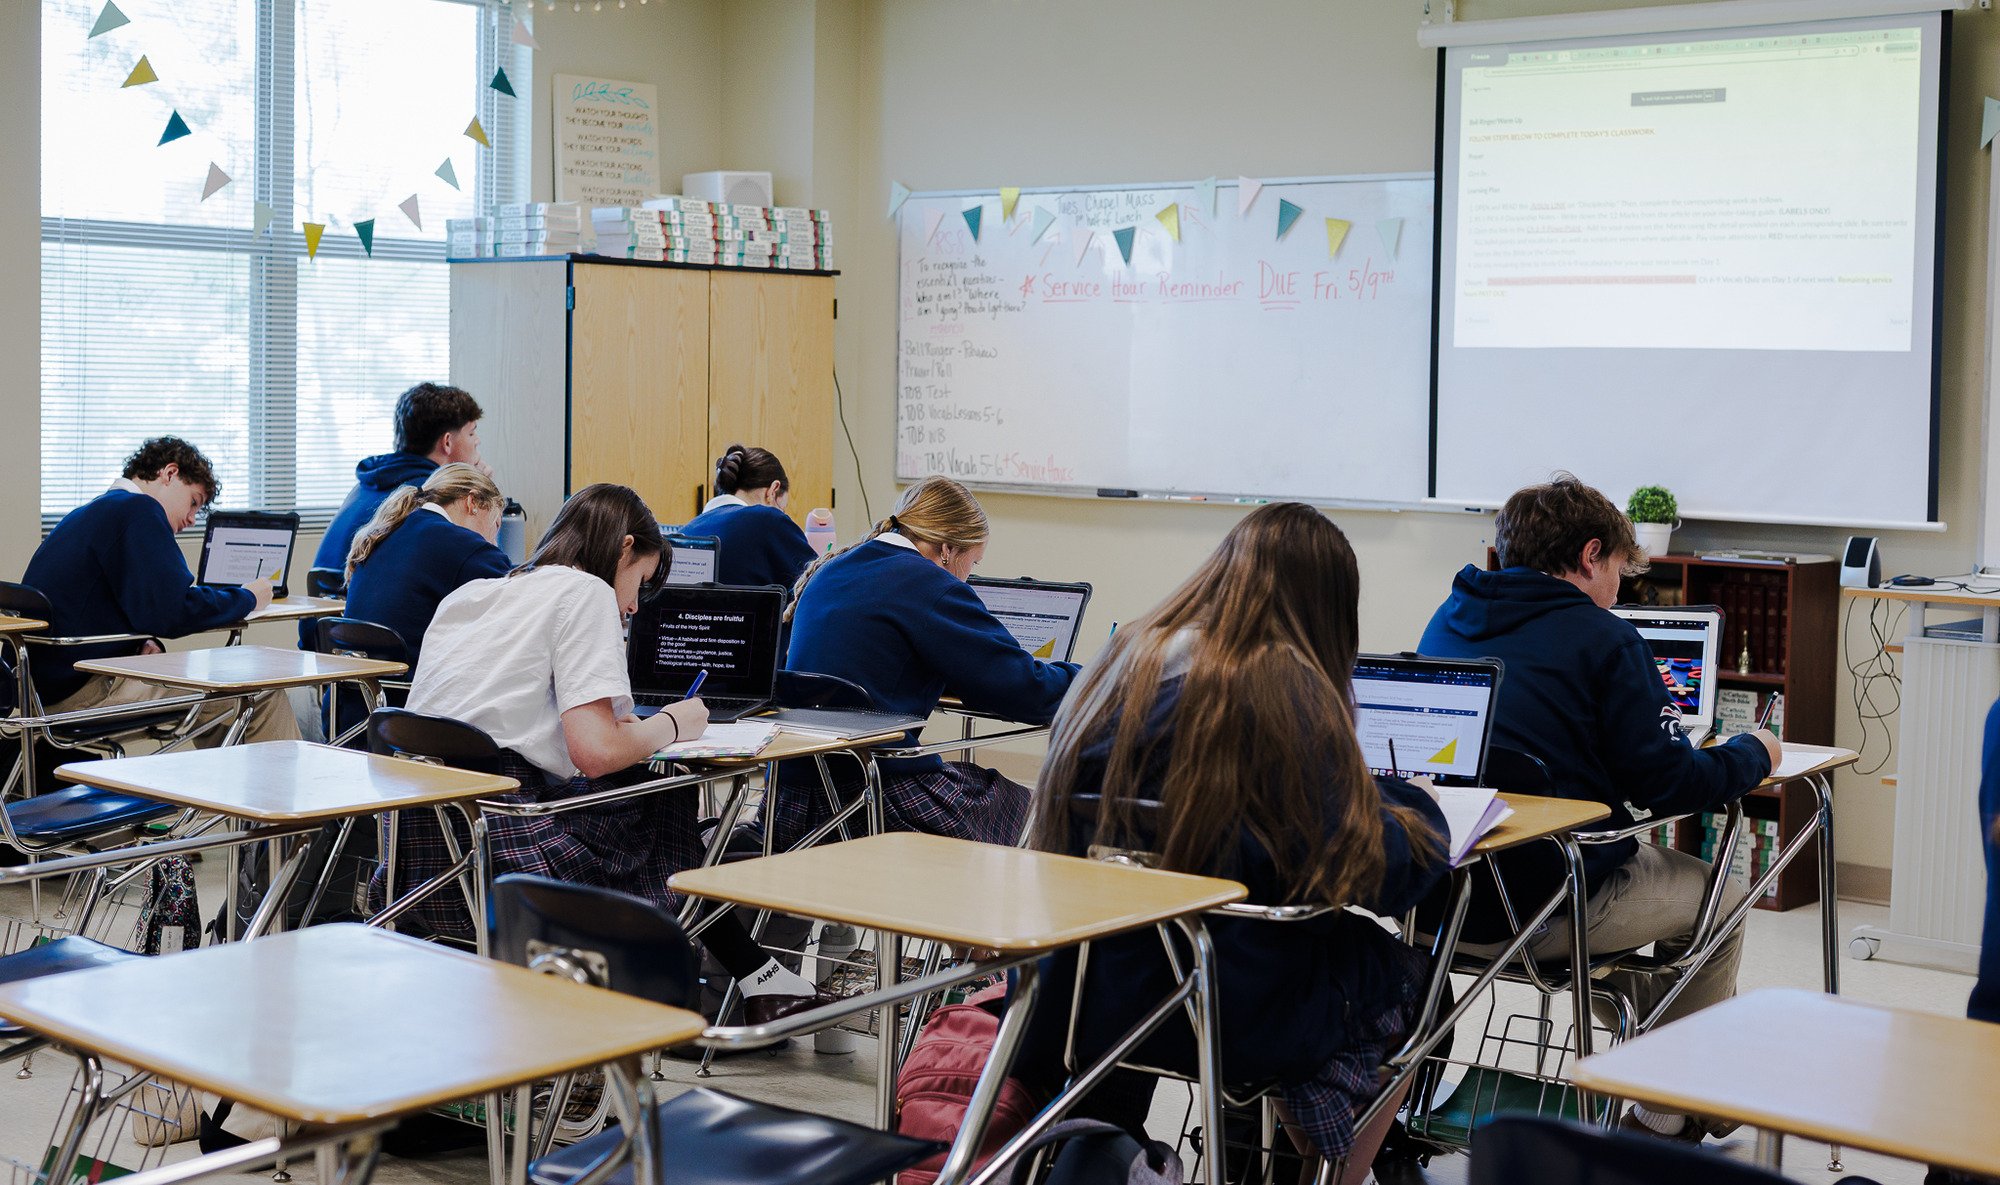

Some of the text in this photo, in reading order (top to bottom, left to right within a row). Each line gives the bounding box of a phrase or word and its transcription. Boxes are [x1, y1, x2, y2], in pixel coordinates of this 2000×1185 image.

[1544, 131, 1578, 140] COMPLETE
[1085, 195, 1119, 213] Chapel
[1042, 273, 1101, 298] Service
[1112, 270, 1148, 297] Hour
[1157, 271, 1244, 298] Reminder
[1257, 259, 1301, 300] DUE
[685, 613, 712, 621] Disciples
[757, 962, 780, 985] AHHS
